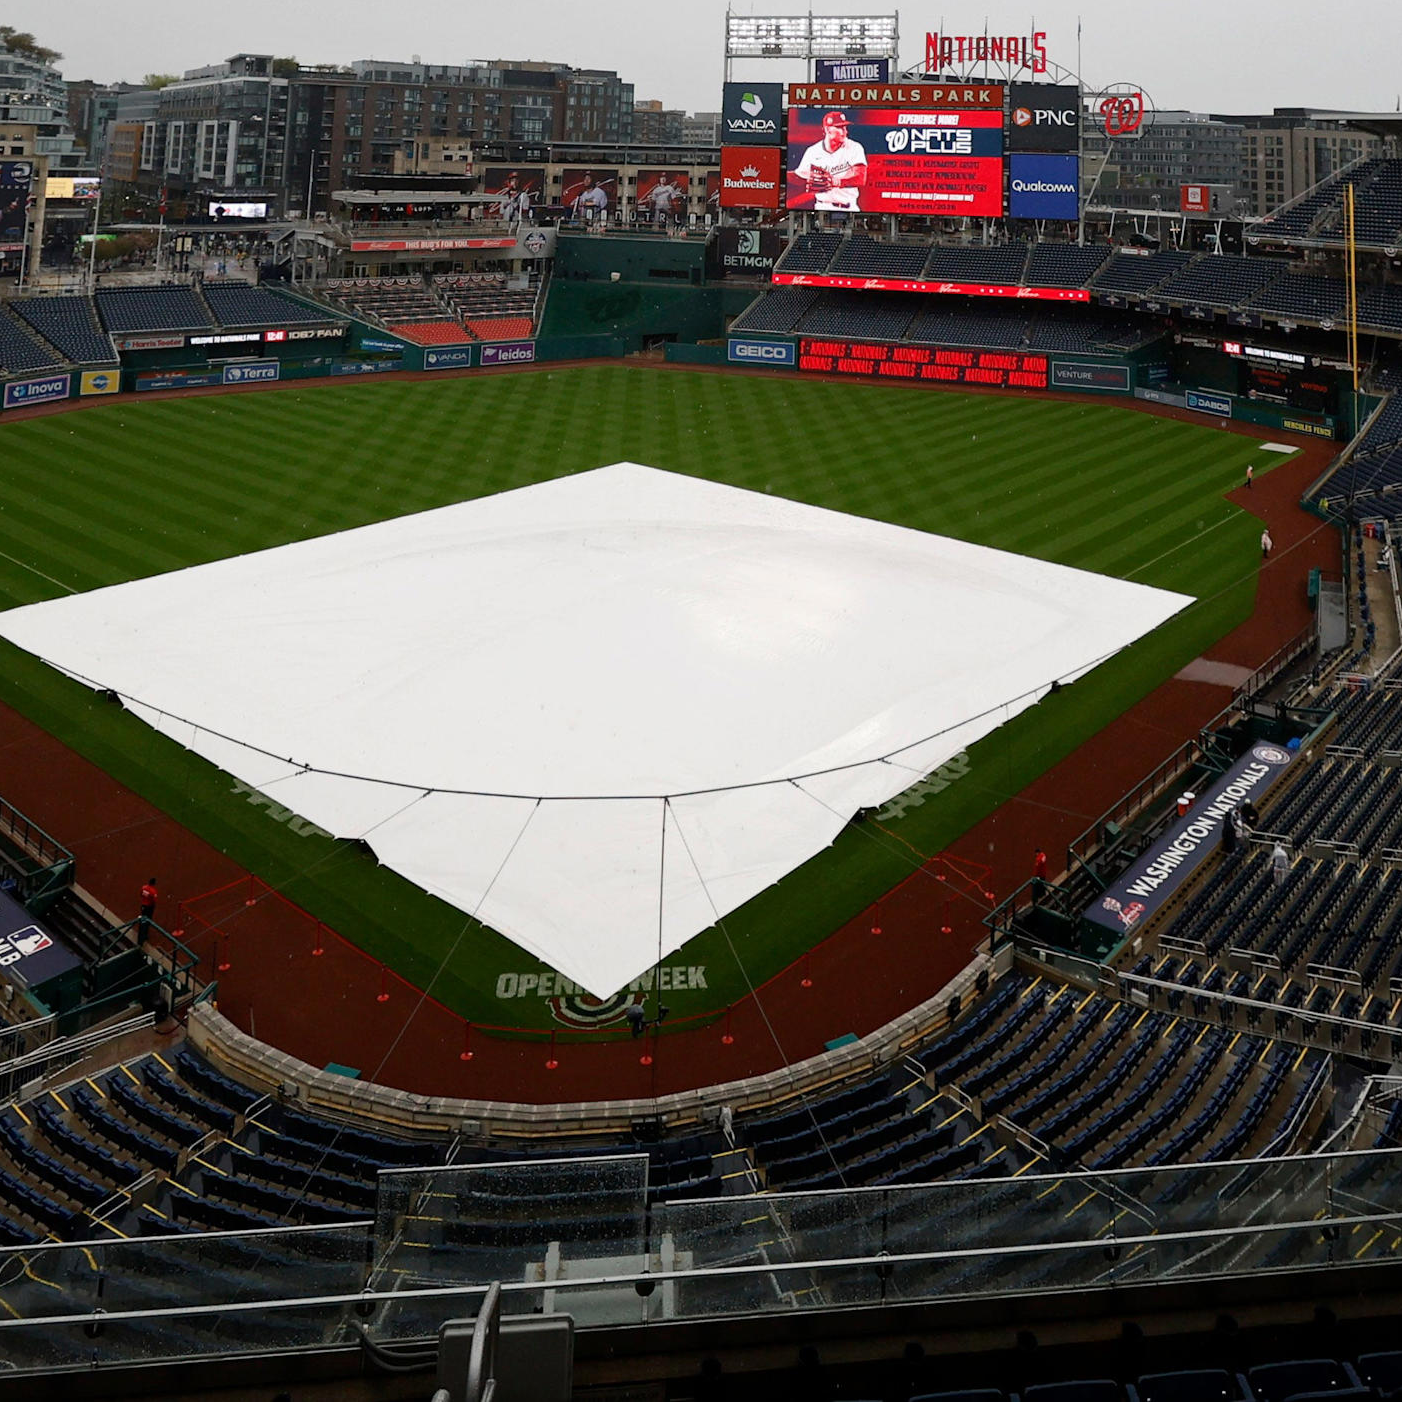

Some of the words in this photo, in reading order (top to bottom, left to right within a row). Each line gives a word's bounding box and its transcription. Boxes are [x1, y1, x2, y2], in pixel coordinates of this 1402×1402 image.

[926, 32, 1046, 73] NATIONALS
[833, 64, 880, 80] NATITUDE
[795, 88, 921, 102] NATIONALS
[932, 89, 991, 103] PARK
[898, 114, 937, 125] EXPERIENCE
[937, 114, 960, 126] MORE!
[1034, 109, 1076, 126] PNC
[727, 119, 776, 129] VANDA
[911, 129, 972, 141] NATS
[911, 141, 972, 154] PLUS
[724, 178, 775, 189] Budweiser
[1012, 179, 1076, 193] Qualcomm
[405, 241, 420, 249] THIS
[421, 240, 440, 249] BUD'S
[440, 239, 454, 248] FOR
[724, 255, 773, 267] BETMGM
[317, 328, 343, 339] FAN
[132, 340, 156, 348] Harris
[158, 338, 182, 347] Teeter
[437, 352, 472, 362] VANDA
[498, 347, 533, 361] leidos
[735, 344, 787, 359] GEICO
[244, 367, 275, 379] Terra
[1056, 370, 1094, 381] VENTURE
[28, 381, 63, 396] Inova
[1284, 420, 1313, 434] HERCULES
[1313, 425, 1333, 438] FENCE
[1126, 816, 1217, 897] WASHINGTON
[1204, 761, 1270, 820] NATIONALS
